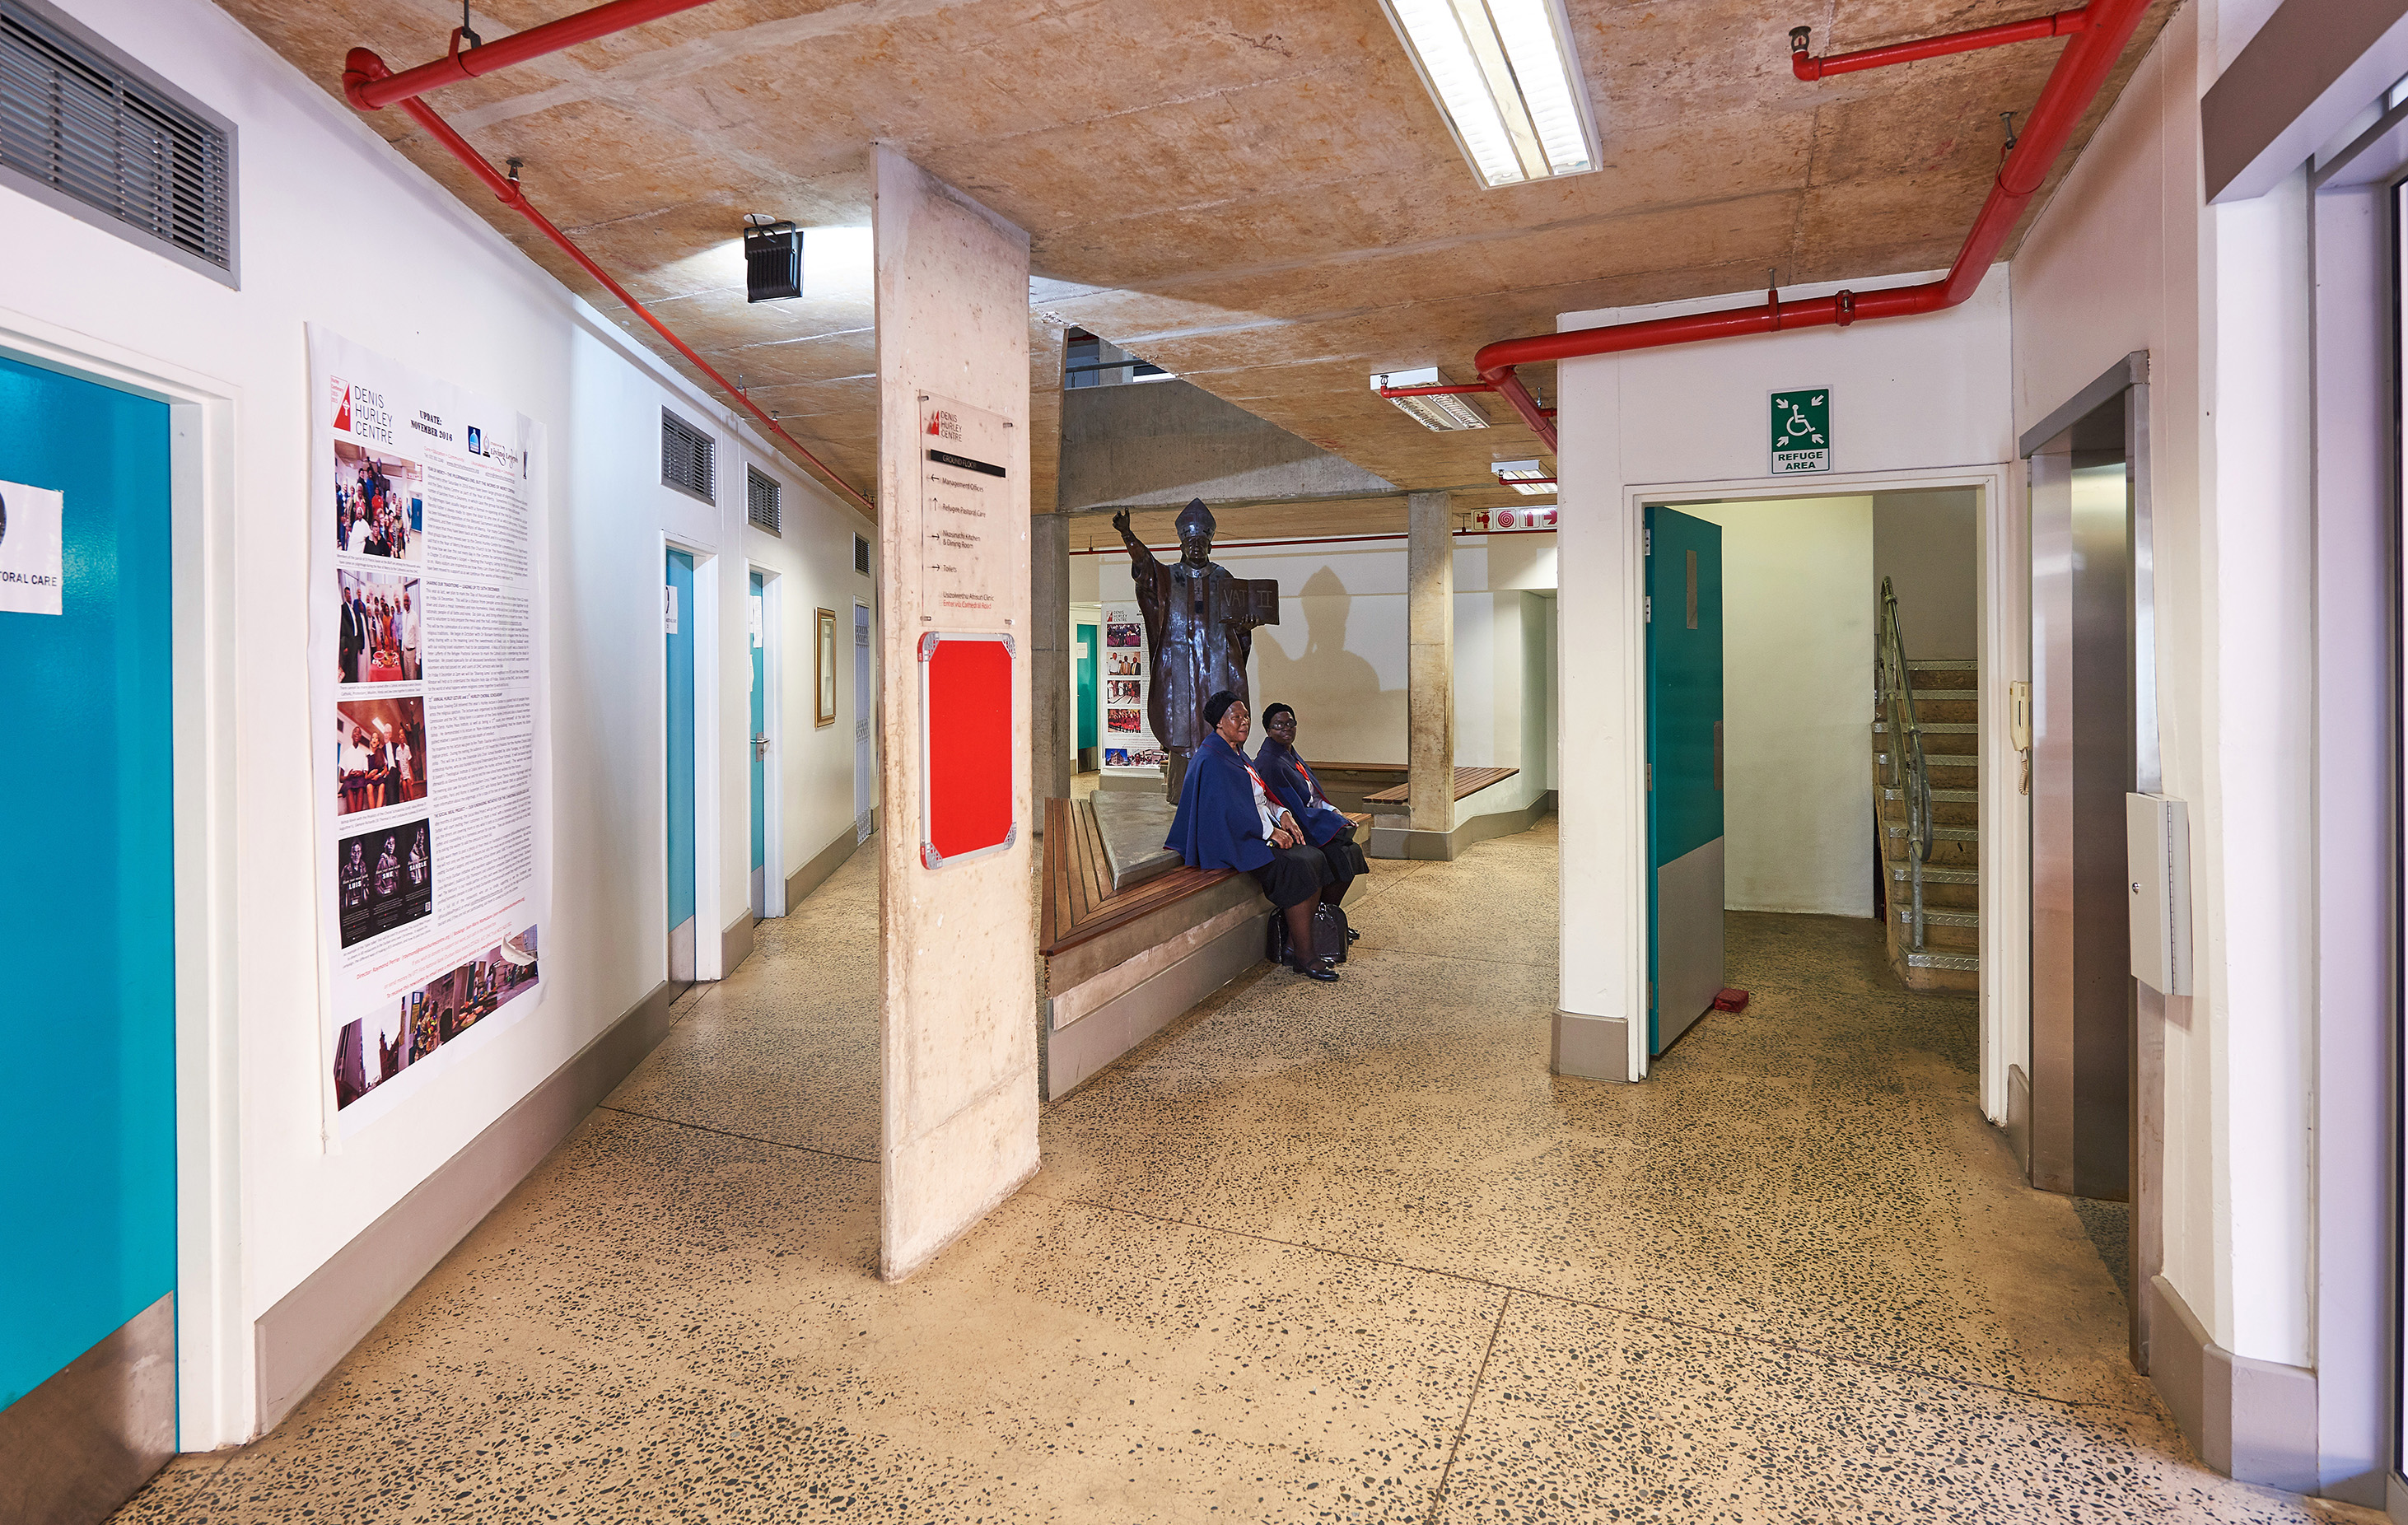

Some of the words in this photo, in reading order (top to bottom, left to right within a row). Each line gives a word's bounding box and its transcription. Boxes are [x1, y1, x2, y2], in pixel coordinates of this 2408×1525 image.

[354, 385, 384, 408] DENIS
[355, 403, 393, 427] HURLEY
[419, 410, 442, 425] UPDATE:
[940, 410, 958, 422] DENIS
[356, 421, 393, 445] CENTRE
[410, 419, 438, 437] NOVEMBER
[439, 431, 453, 441] 2016
[940, 420, 962, 433] HURLEY
[940, 429, 962, 442] CENTRE
[942, 455, 962, 465] GROUND
[962, 460, 977, 469] FLOOR
[1778, 451, 1823, 461] REFUGE
[1785, 461, 1816, 470] AREA
[942, 478, 969, 490] Management
[969, 483, 984, 492] Offices
[942, 503, 960, 514] Refugee
[960, 506, 977, 516] Pastoral
[946, 539, 961, 549] Dining
[965, 534, 981, 542] Kitchen
[943, 564, 957, 573] Toilets
[0, 571, 29, 584] ORAL
[31, 574, 57, 586] CARE
[1223, 589, 1248, 607] VAT
[1257, 590, 1273, 608] II
[348, 880, 362, 890] LUIS
